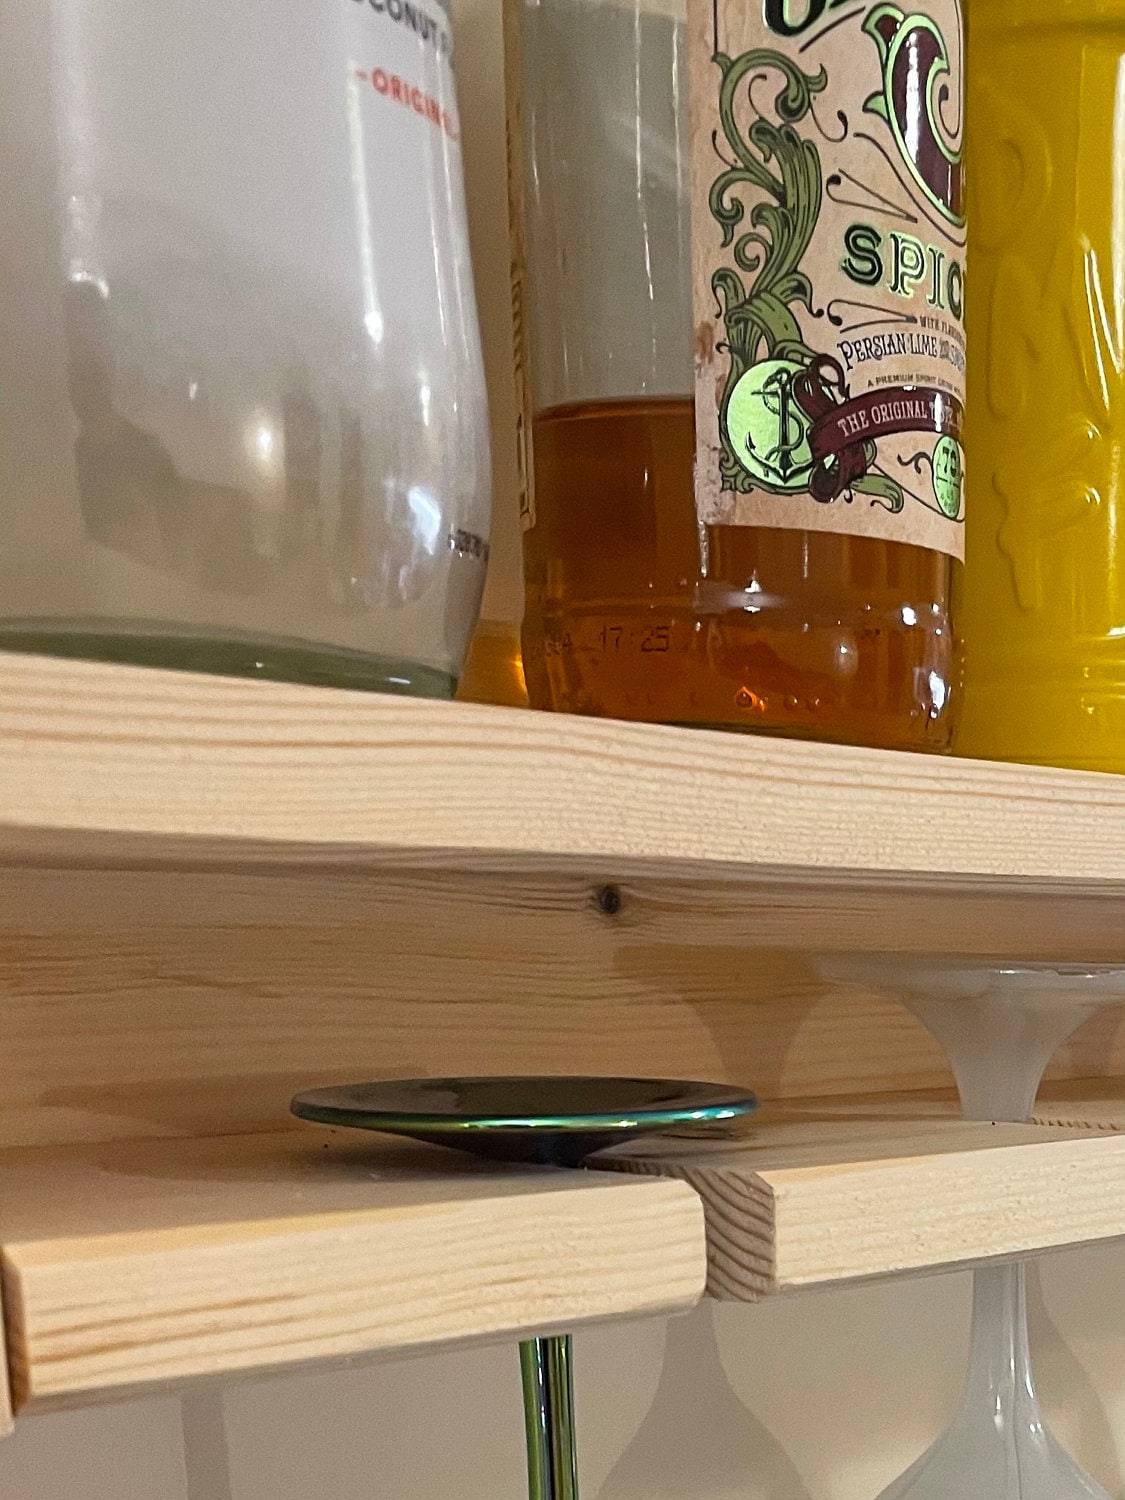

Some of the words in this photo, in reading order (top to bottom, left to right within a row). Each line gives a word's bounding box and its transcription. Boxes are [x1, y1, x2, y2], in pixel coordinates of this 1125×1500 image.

[837, 333, 907, 371] PERSIAN
[908, 332, 938, 358] LIME
[867, 379, 874, 388] A
[876, 374, 914, 385] PREMIUM
[837, 410, 870, 437] THE
[871, 400, 928, 425] ORIGINAL
